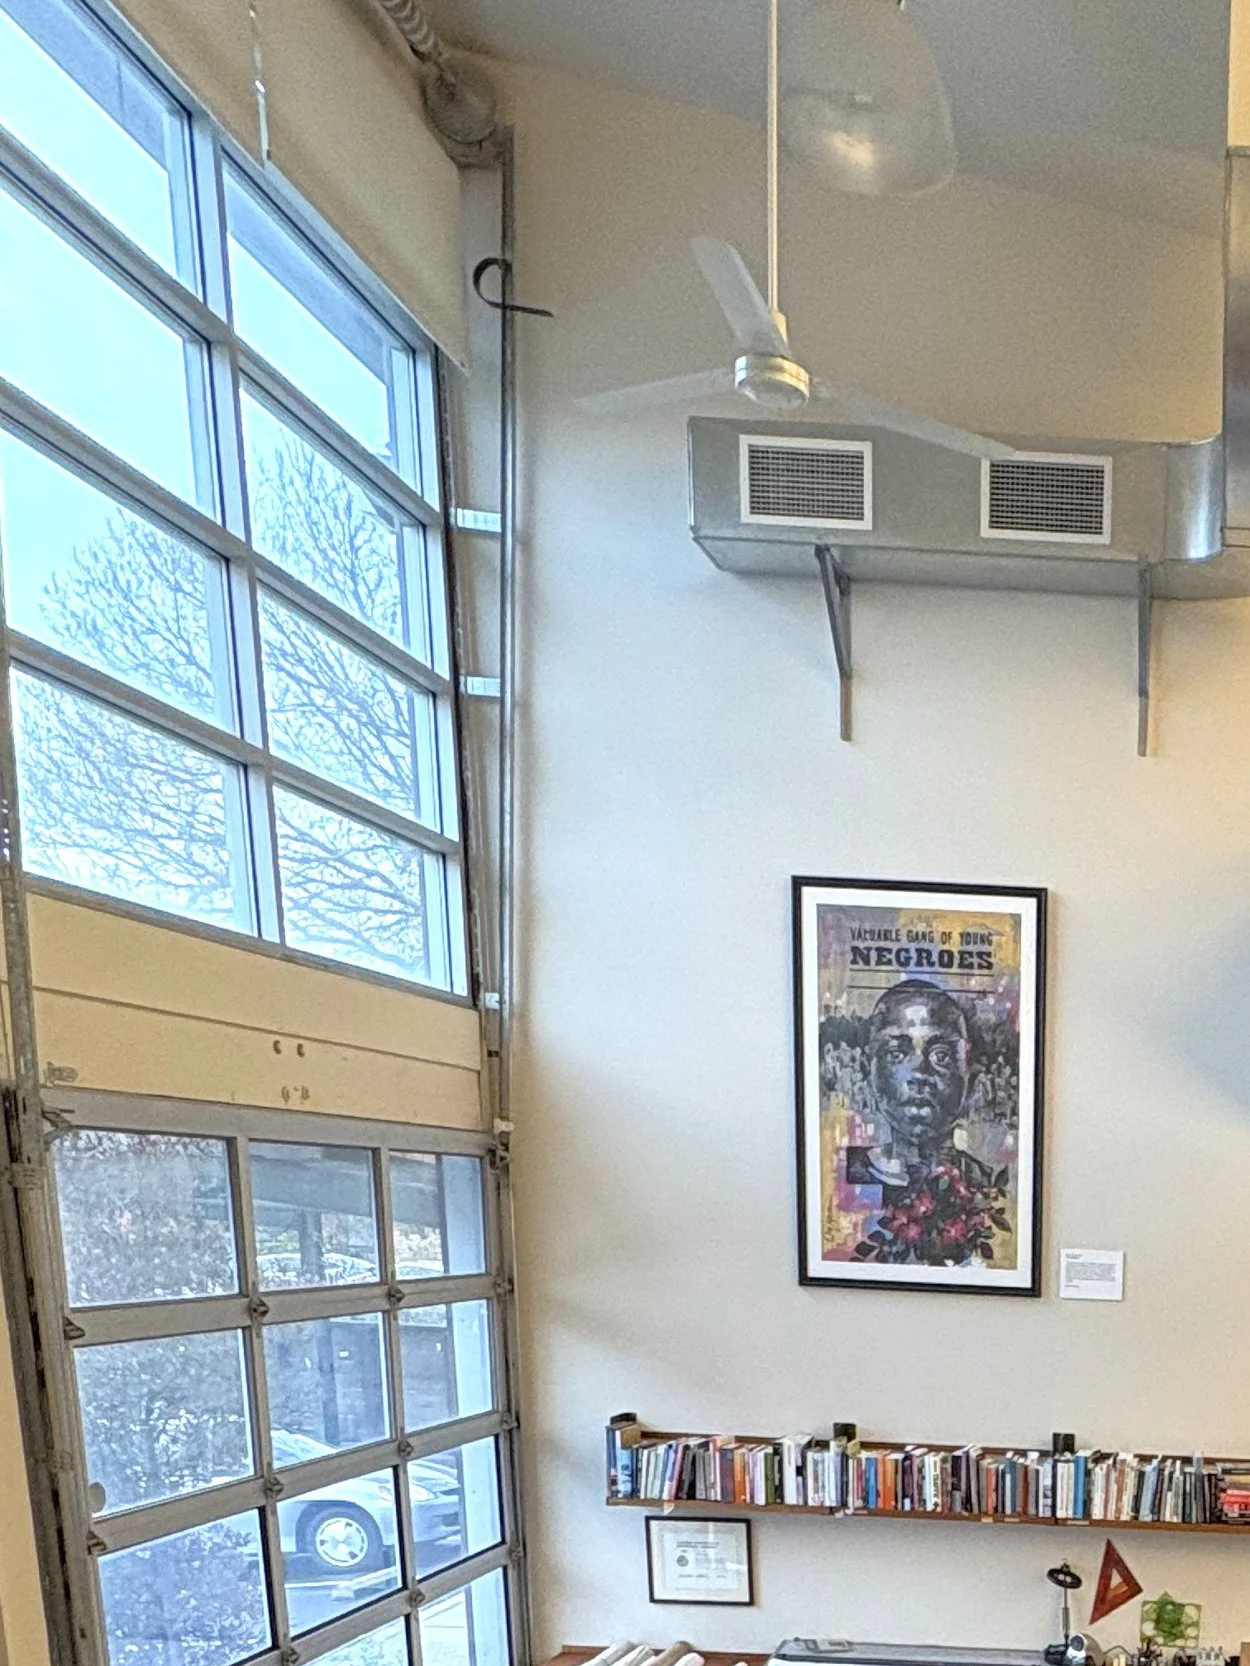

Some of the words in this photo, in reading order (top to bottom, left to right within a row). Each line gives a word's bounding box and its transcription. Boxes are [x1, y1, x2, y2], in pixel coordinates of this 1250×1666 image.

[850, 927, 901, 942] VALUABLE
[906, 929, 934, 944] GANG
[941, 931, 953, 945] OF
[959, 931, 994, 947] YOUNG
[850, 946, 994, 970] NEGROES
